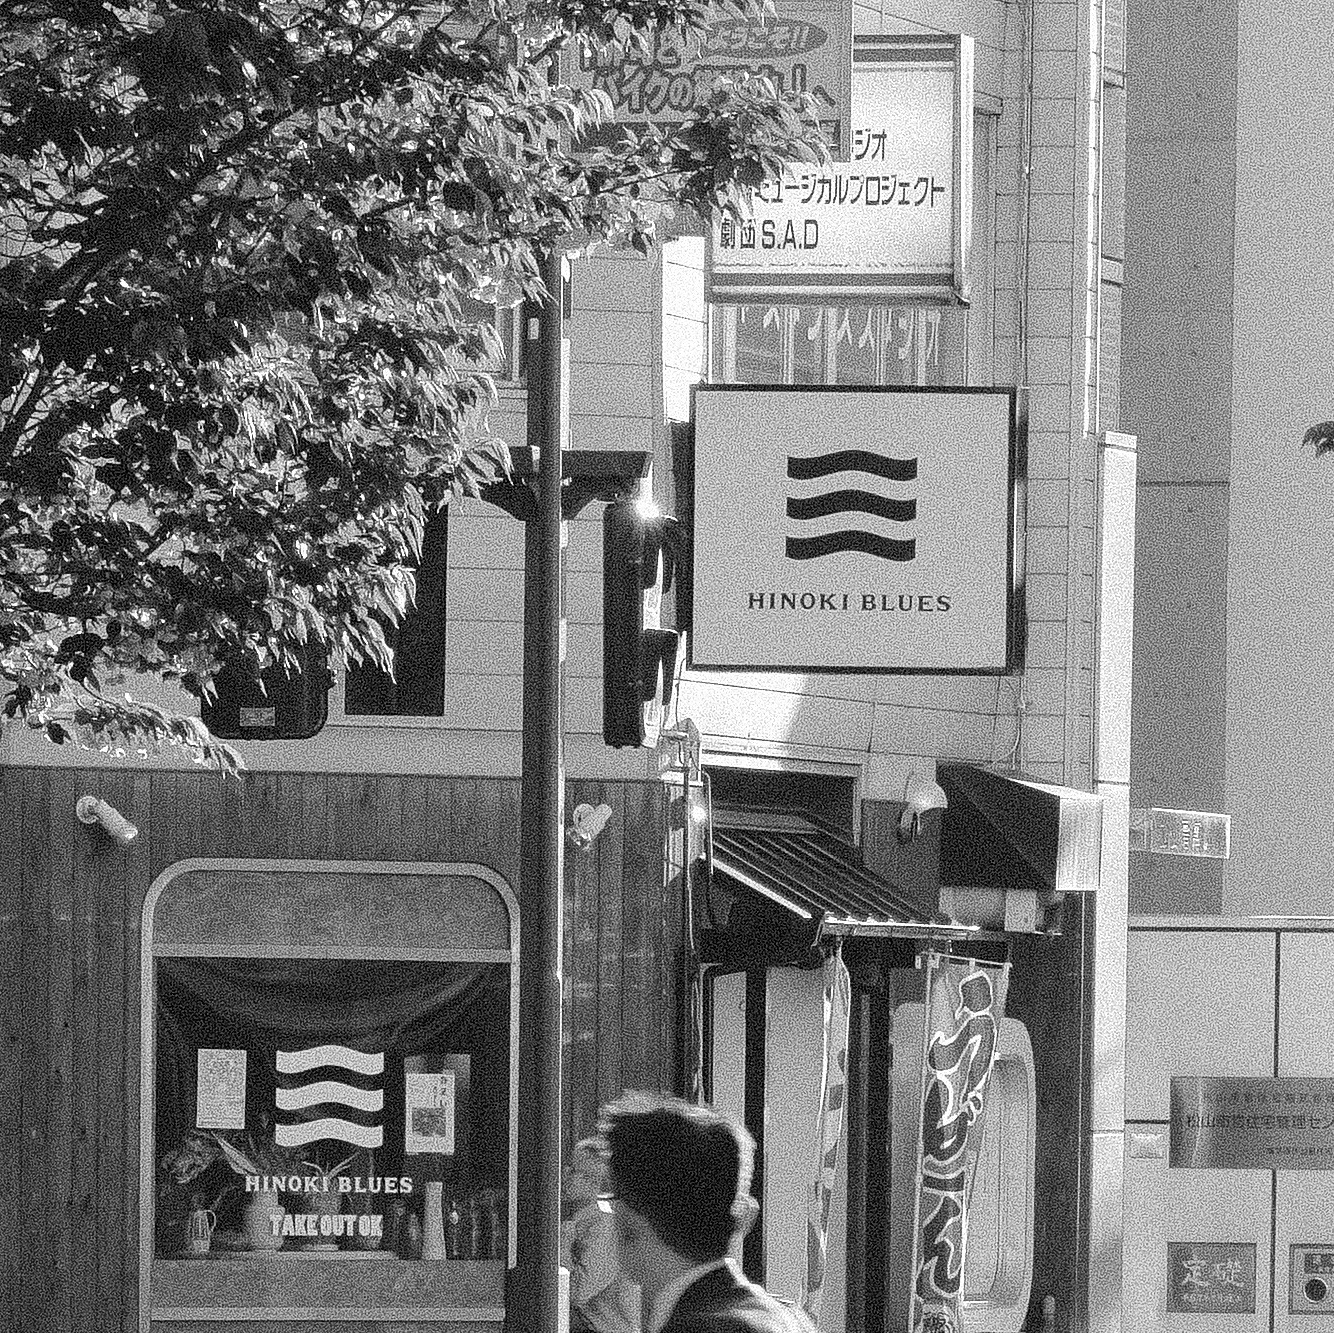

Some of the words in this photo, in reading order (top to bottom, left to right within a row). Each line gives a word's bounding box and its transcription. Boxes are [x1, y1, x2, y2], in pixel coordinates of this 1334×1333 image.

[748, 592, 849, 611] HINOKI
[861, 593, 952, 612] BLUES
[245, 1175, 329, 1193] HINOKI
[338, 1176, 413, 1194] BLUES
[270, 1214, 318, 1237] TAKE
[320, 1214, 357, 1237] OUT
[358, 1214, 383, 1237] OK
[1181, 1254, 1245, 1288] 定礎
